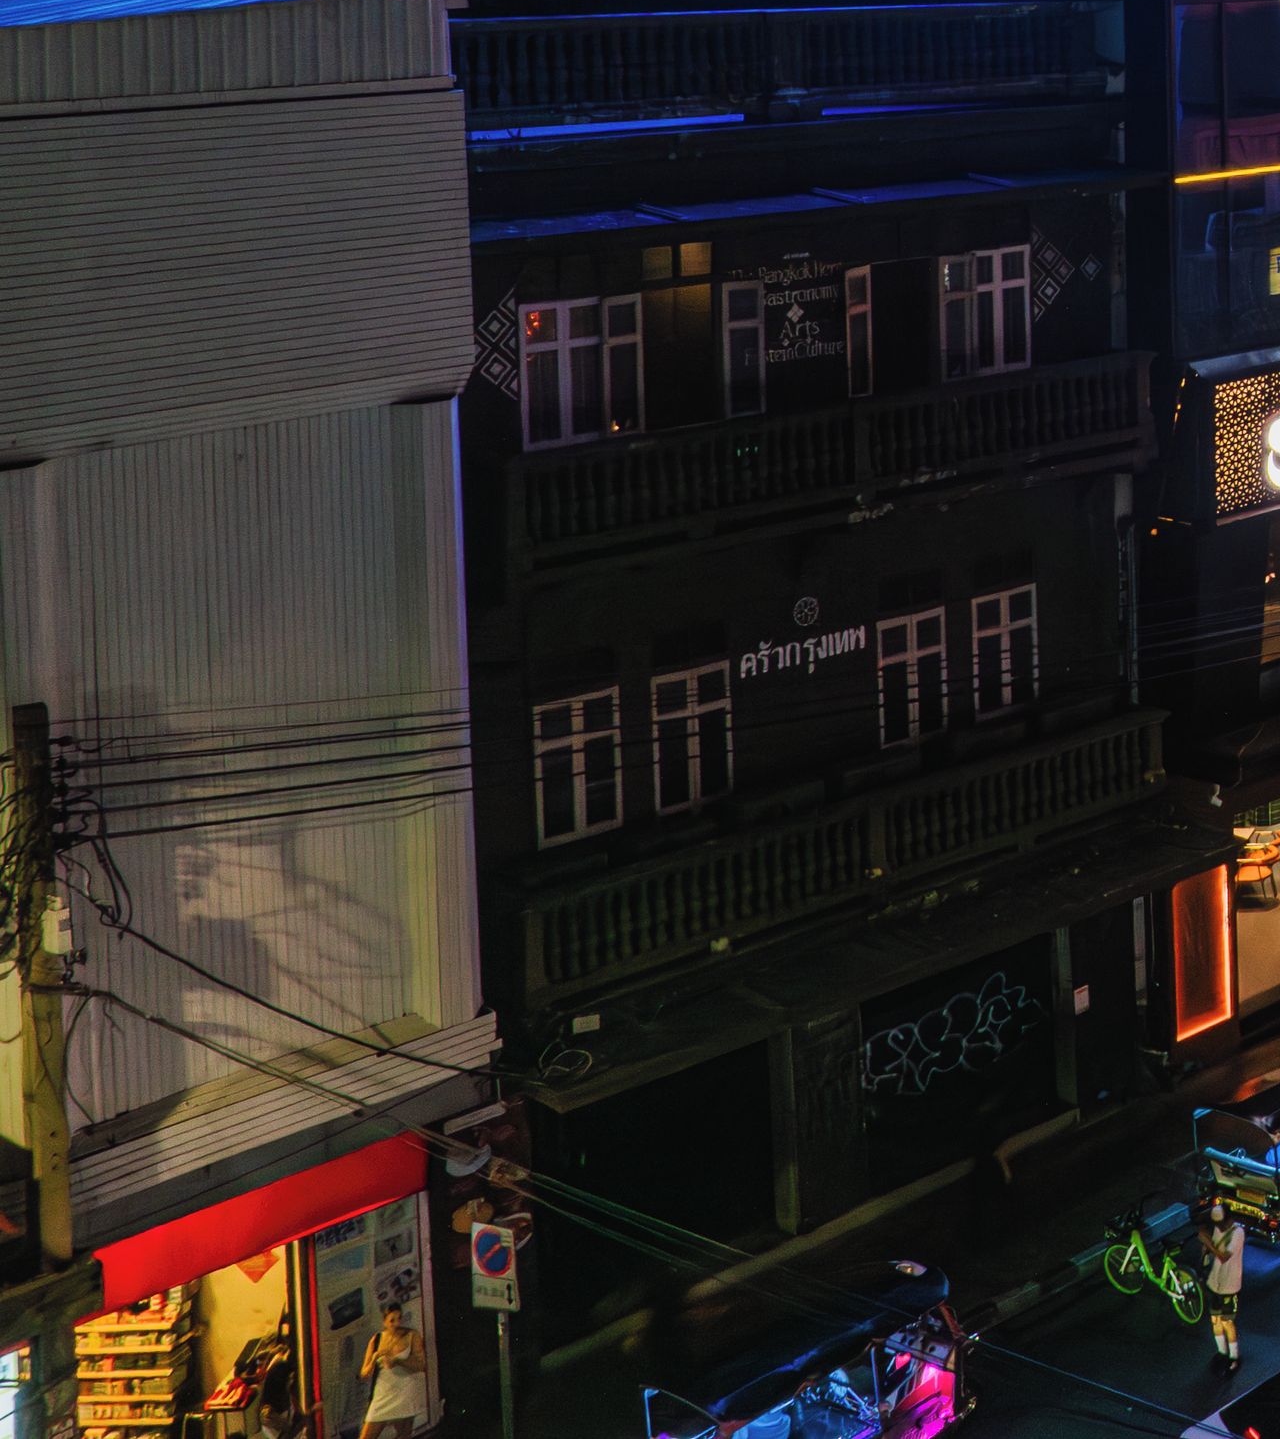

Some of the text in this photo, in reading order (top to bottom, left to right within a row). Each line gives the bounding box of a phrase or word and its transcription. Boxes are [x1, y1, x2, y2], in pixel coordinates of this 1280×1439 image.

[780, 320, 820, 340] Arts
[740, 624, 866, 679] ครัวกรุงเทพ
